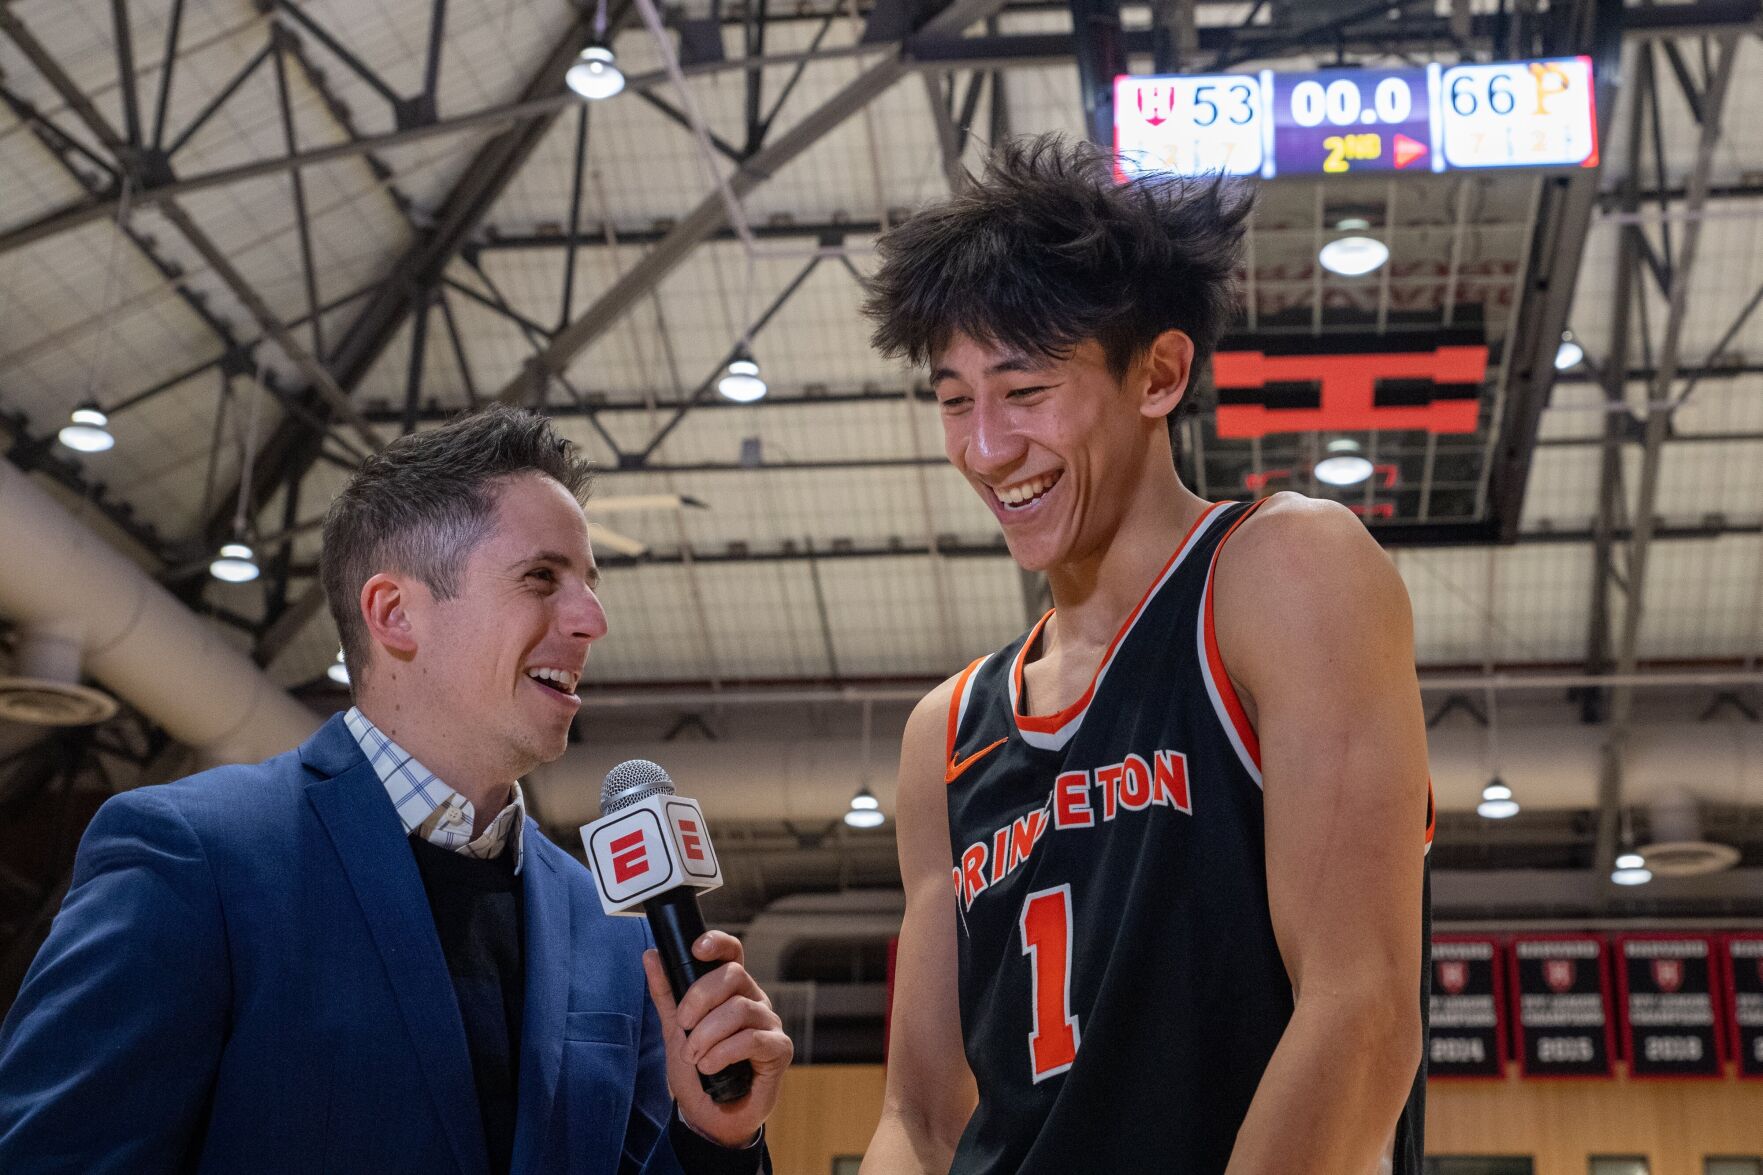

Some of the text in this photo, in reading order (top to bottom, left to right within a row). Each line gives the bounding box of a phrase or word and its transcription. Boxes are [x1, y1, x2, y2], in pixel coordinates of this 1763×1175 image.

[1193, 84, 1254, 127] 53
[1290, 76, 1412, 127] 00.0
[1450, 73, 1516, 117] 66
[1528, 61, 1570, 116] P
[952, 748, 1193, 914] PRINETON
[1019, 882, 1082, 1085] 1
